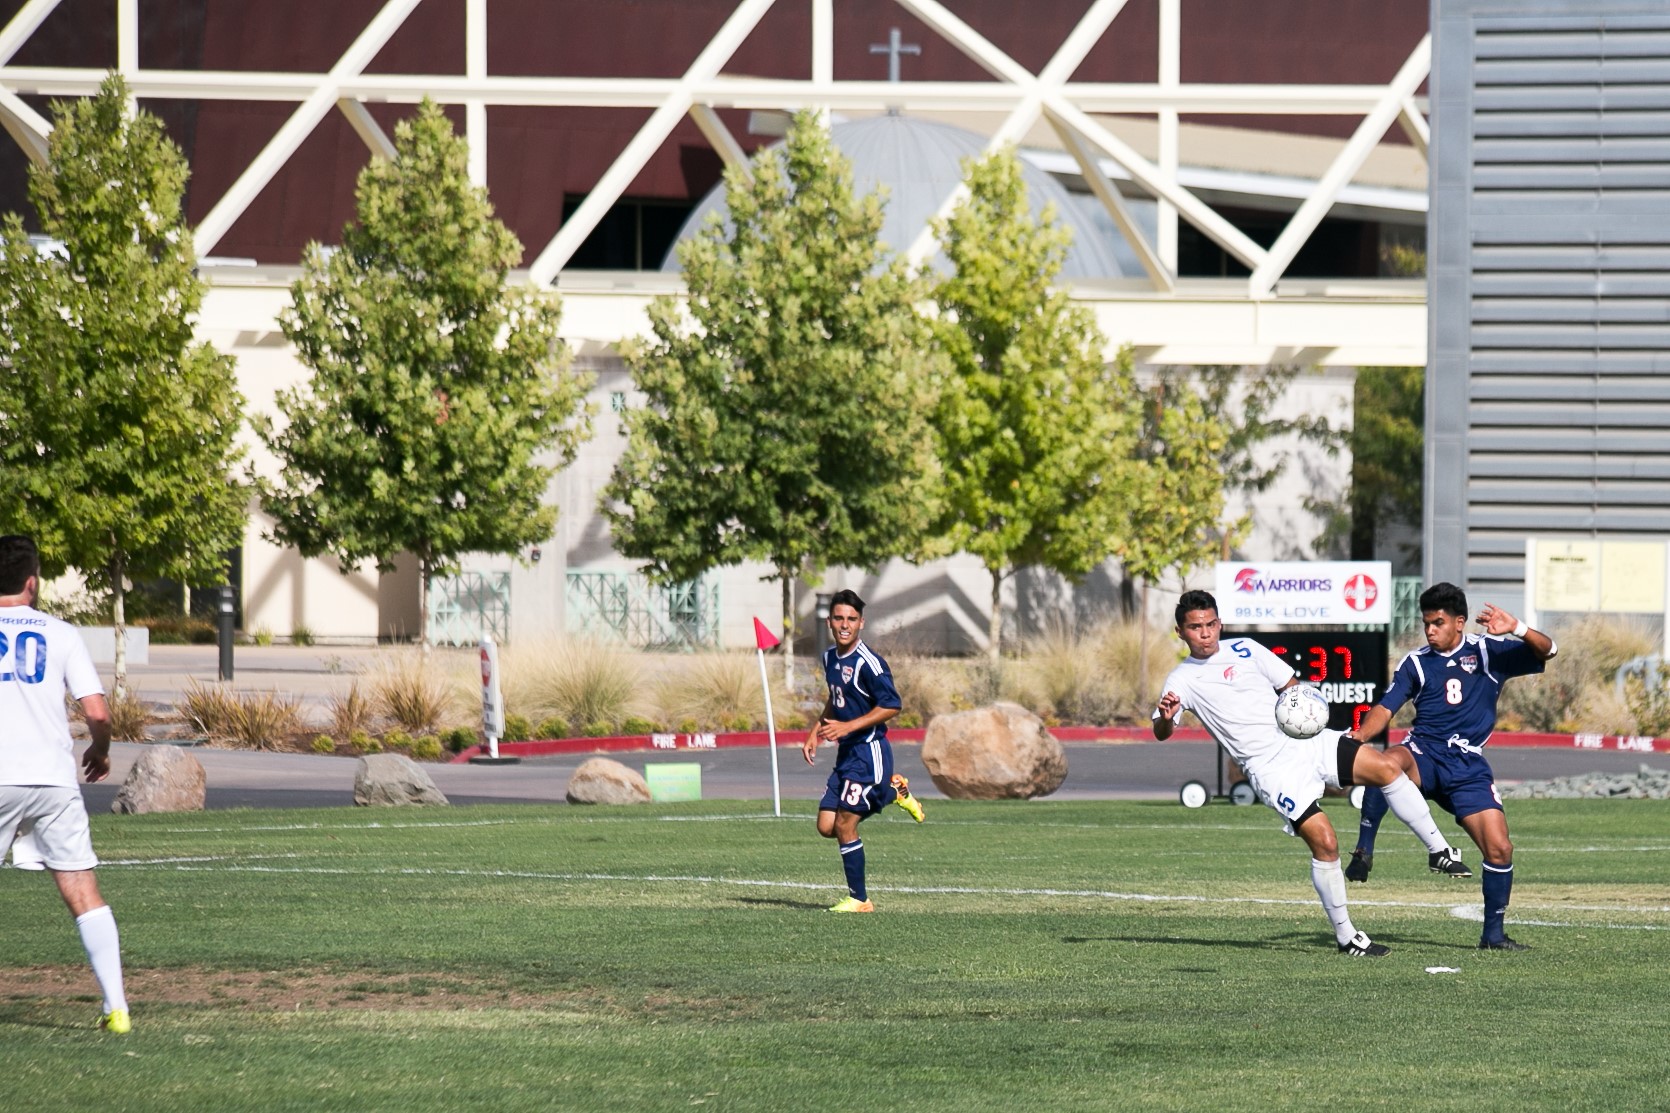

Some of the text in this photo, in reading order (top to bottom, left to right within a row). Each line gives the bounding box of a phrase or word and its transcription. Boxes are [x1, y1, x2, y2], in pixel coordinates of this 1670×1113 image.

[1235, 607, 1262, 618] 99.5
[1284, 607, 1330, 618] LOVE
[1231, 641, 1252, 658] 5
[830, 684, 846, 709] 13
[1320, 682, 1376, 704] GUEST
[1446, 678, 1464, 705] 8
[652, 733, 717, 749] FIRE LANE
[1574, 733, 1655, 752] FIRE LANE
[840, 779, 863, 806] 13
[1277, 793, 1296, 813] 5
